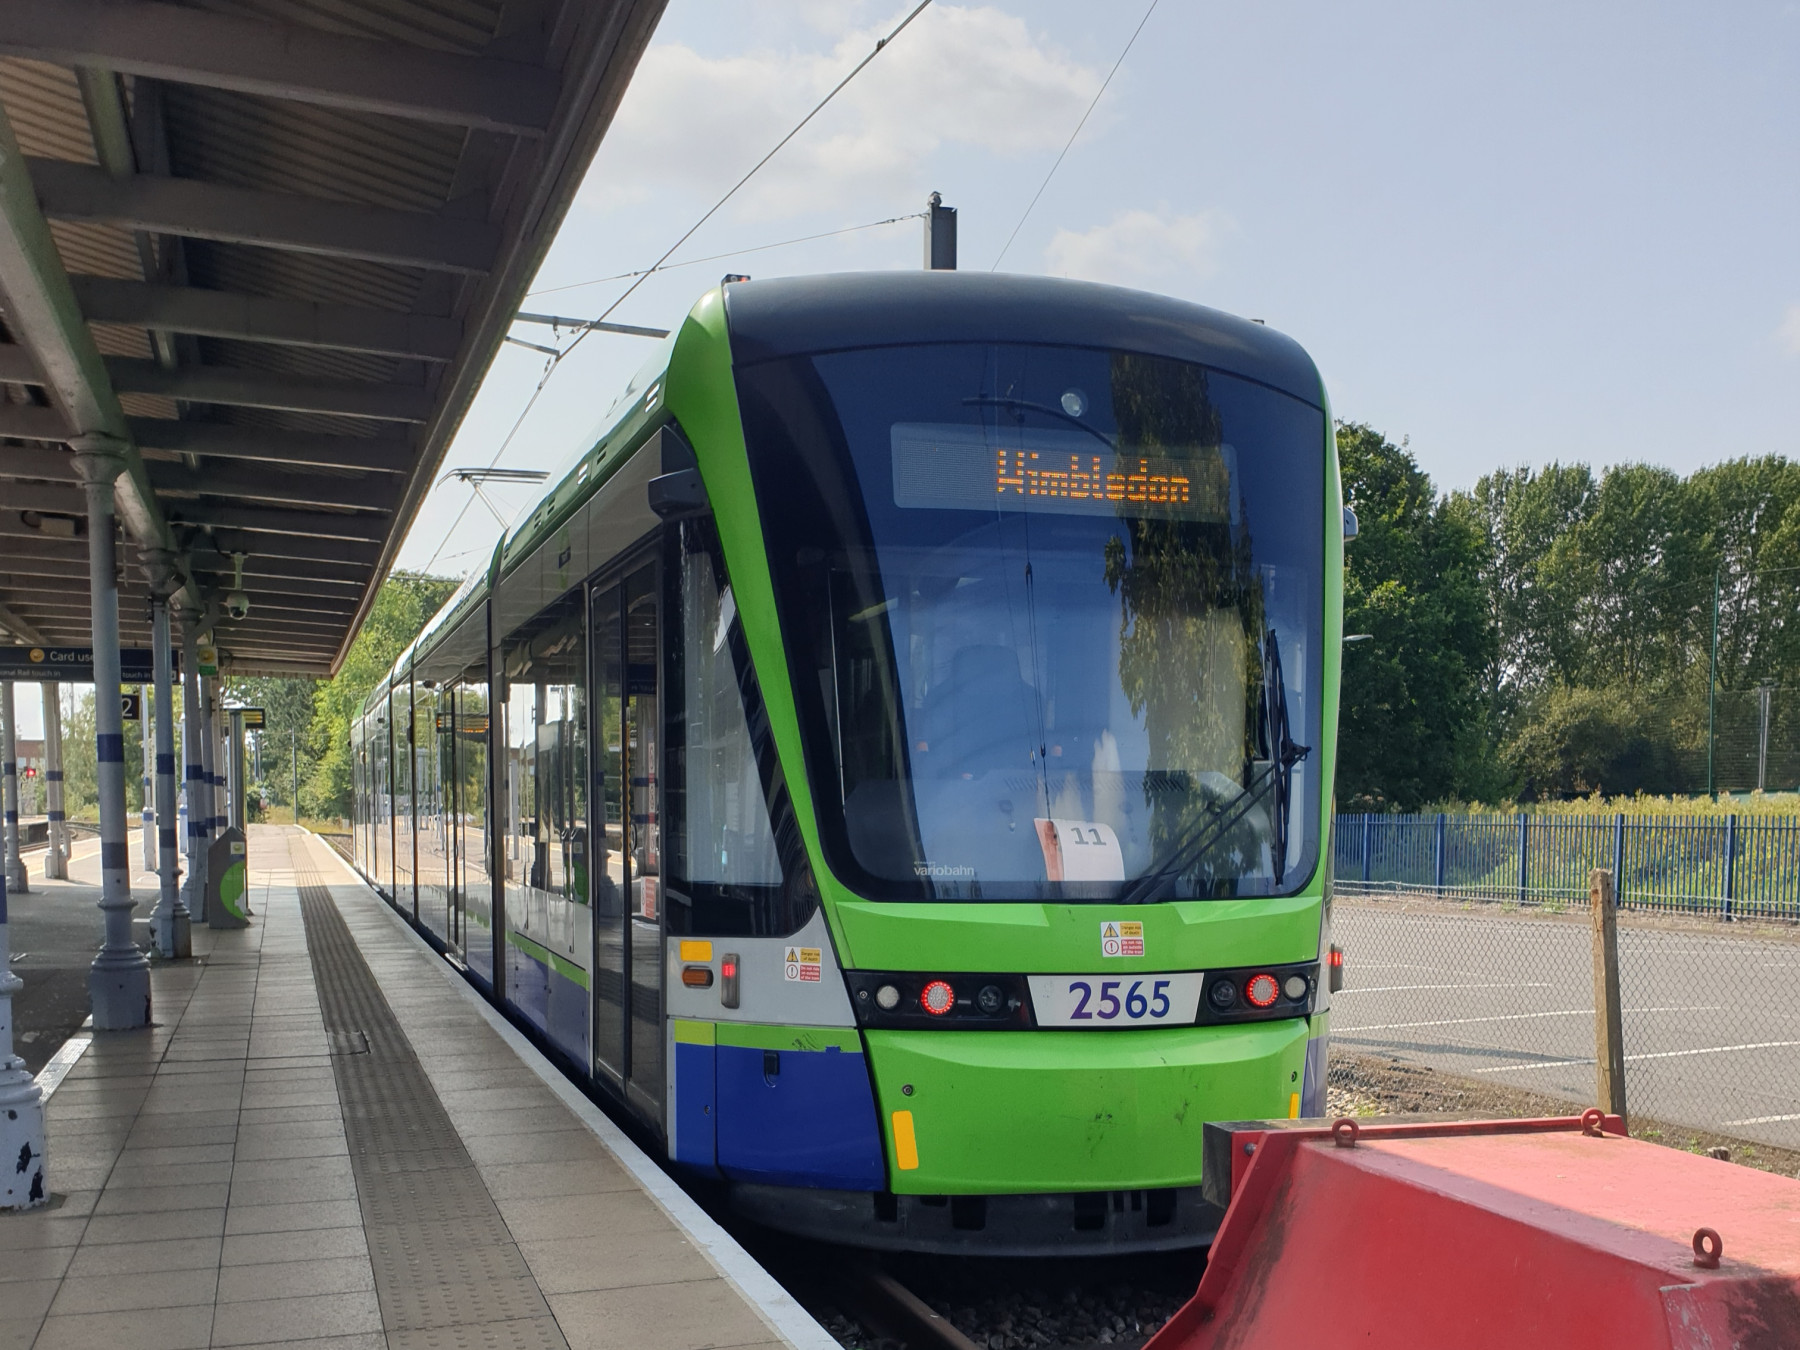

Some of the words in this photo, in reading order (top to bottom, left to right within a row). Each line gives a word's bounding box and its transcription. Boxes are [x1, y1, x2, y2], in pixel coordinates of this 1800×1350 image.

[997, 450, 1190, 502] Wimbledon
[50, 651, 75, 662] Card
[122, 670, 143, 679] touch
[1071, 827, 1107, 846] 11
[913, 864, 975, 876] variobahn
[1069, 980, 1171, 1020] 2565
